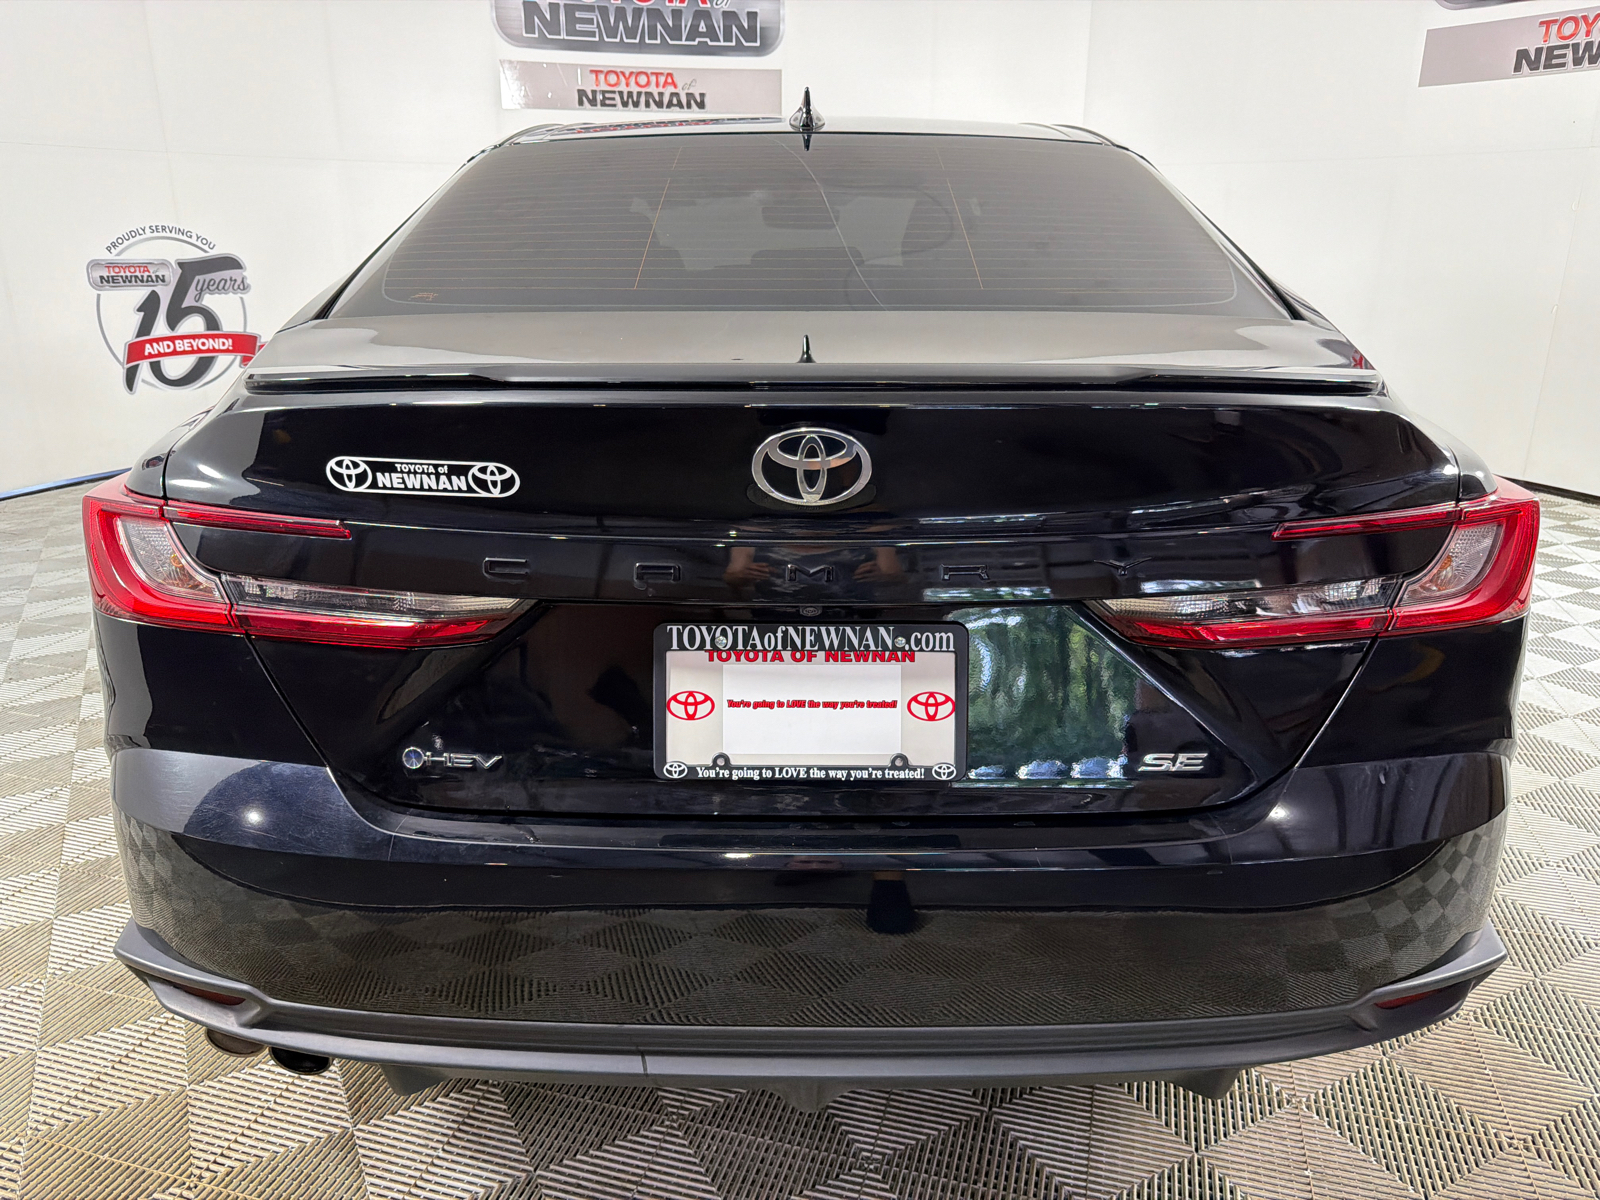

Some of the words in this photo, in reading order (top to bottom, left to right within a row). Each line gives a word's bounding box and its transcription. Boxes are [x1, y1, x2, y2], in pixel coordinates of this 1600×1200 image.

[523, 0, 760, 46] NEWNAN
[1538, 12, 1600, 43] TOY
[589, 69, 678, 89] TOYOTA
[681, 78, 697, 91] of
[577, 88, 706, 110] NEWNAN
[105, 225, 147, 254] PROUDLY
[149, 224, 193, 240] SERVING
[195, 232, 217, 251] YOU
[105, 265, 150, 274] TOYOTA
[99, 274, 166, 285] NEWNAN
[126, 256, 244, 392] 15
[194, 275, 249, 303] years
[144, 340, 174, 356] AND
[177, 337, 233, 355] BEYOND!
[395, 463, 435, 473] TOYOTA
[437, 464, 449, 474] of
[376, 472, 468, 491] NEWNAN
[482, 555, 1152, 583] CAMRY
[704, 649, 785, 663] TOYOTA
[790, 650, 818, 663] OF
[825, 650, 916, 663] NEWNAN
[726, 699, 752, 708] You're
[752, 699, 776, 710] going
[776, 699, 785, 708] to
[786, 699, 807, 708] LOVE
[807, 699, 821, 708] the
[822, 701, 840, 710] way
[839, 699, 866, 710] you're
[866, 699, 898, 708] treated!
[1137, 752, 1209, 772] SE
[695, 766, 730, 778] You're
[731, 767, 760, 781] going
[762, 767, 773, 778] to
[774, 767, 808, 779] LOVE
[809, 767, 826, 778] the
[828, 769, 848, 781] way
[849, 768, 883, 781] you're
[884, 768, 925, 779] treated!
